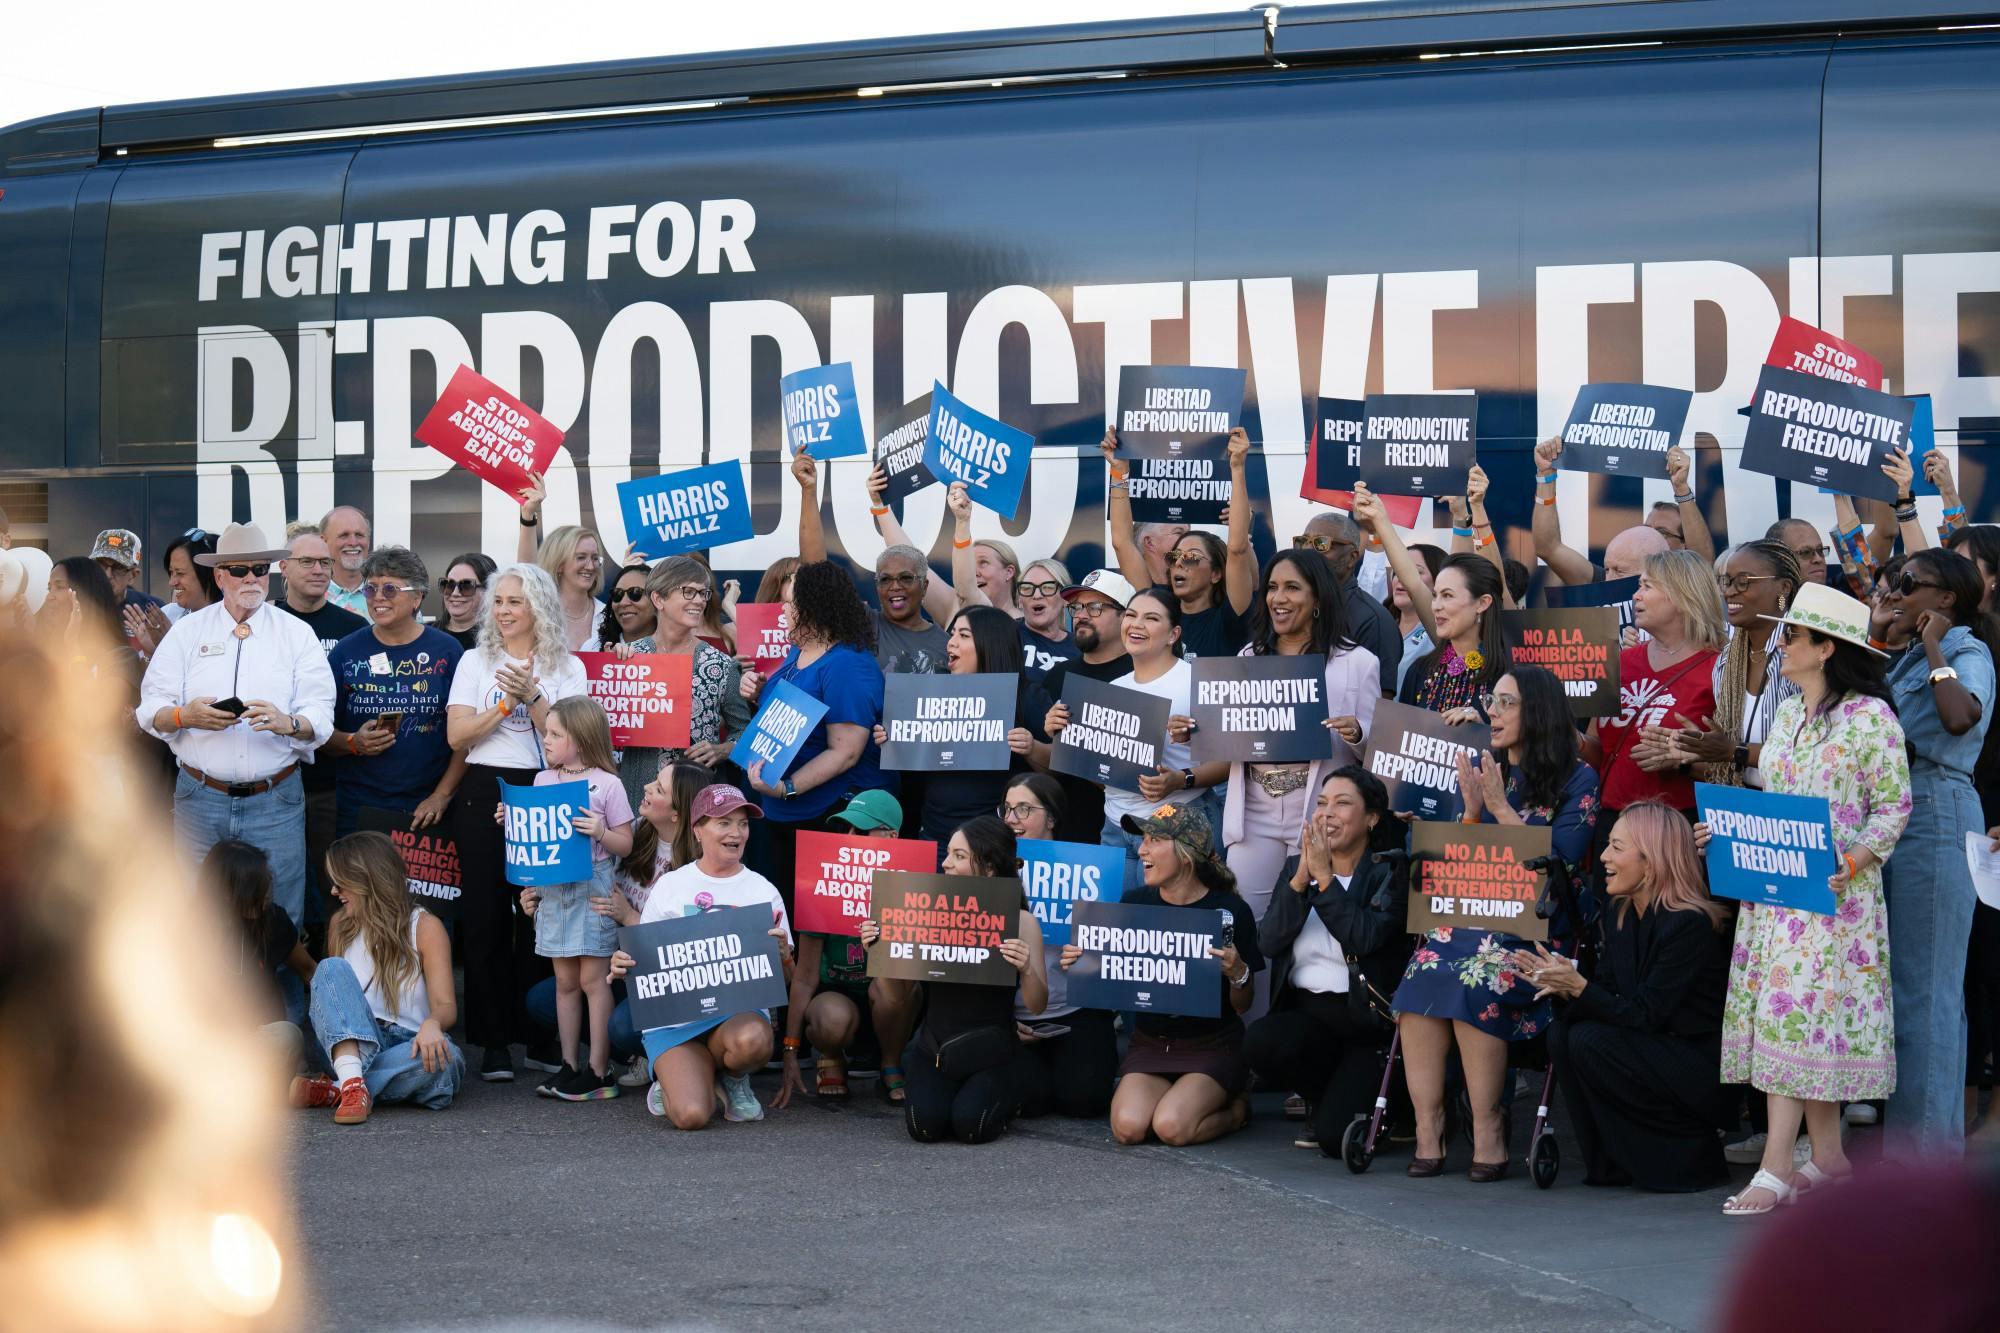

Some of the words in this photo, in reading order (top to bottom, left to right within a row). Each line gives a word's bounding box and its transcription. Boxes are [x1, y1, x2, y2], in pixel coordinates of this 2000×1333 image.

[198, 209, 566, 301] FIGHTING
[587, 198, 757, 281] FOR
[1813, 343, 1857, 370] STOP
[785, 383, 841, 427] HARRIS
[1145, 387, 1211, 410] LIBERTAD
[484, 396, 530, 429] STOP
[1124, 411, 1229, 433] REPRODUCTIVA
[1590, 403, 1656, 428] LIBERTAD
[1761, 389, 1904, 446] REPRODUCTIVE
[464, 399, 536, 454] TRUMP'S
[792, 421, 833, 447] WALZ
[877, 413, 931, 461] REPRODUCTIV
[1367, 417, 1470, 442] REPRODUCTIVE
[1565, 424, 1671, 452] REPRODUCTIVA
[448, 410, 534, 471] ABORTION
[935, 405, 1011, 475] HARRIS
[1782, 424, 1872, 467] FREEDOM
[464, 438, 503, 469] BAN
[1385, 443, 1449, 468] FREEDOM
[938, 444, 991, 489] WALZ
[1142, 459, 1213, 479] LIBERTAD
[1128, 478, 1233, 501] EPRODUCTIVA
[637, 480, 730, 527] HARRIS
[656, 513, 721, 542] WALZ
[1523, 629, 1543, 645] NO
[1546, 629, 1558, 645] A
[1561, 628, 1584, 645] LA
[1512, 642, 1607, 663] PROHIBICIÓN
[602, 664, 651, 680] STOP
[1545, 663, 1607, 681] MISTA
[388, 696, 408, 704] too
[412, 694, 439, 704] hard
[587, 680, 667, 697] TRUMP'S
[1198, 678, 1320, 705] REPRODUCTIVE
[1564, 680, 1598, 697] UMP
[592, 697, 673, 714] BORTION
[916, 697, 986, 719] LIBERTAD
[607, 713, 644, 729] BAN
[757, 698, 808, 747] HARRIS
[890, 719, 1004, 743] REPRODUCTIVA
[1081, 702, 1141, 738] LIBERTAD
[1222, 706, 1296, 732] FREEDOM
[750, 731, 782, 764] WALZ
[1060, 723, 1155, 768] REPRODUCTIVA
[1371, 750, 1459, 794] REPRODUC
[503, 802, 573, 843] ARRIS
[1705, 808, 1828, 850] REPRODUCTIVE
[390, 830, 416, 847] NO
[418, 836, 431, 851] A
[435, 838, 457, 855] LA
[505, 841, 561, 866] WALZ
[1444, 843, 1470, 861] NO
[1474, 844, 1487, 862] A
[1491, 845, 1515, 863] LA
[838, 847, 891, 867] STOP
[1731, 841, 1808, 878] FREEDOM
[821, 863, 900, 883] TRUM
[1018, 860, 1100, 901] ARRIS
[1422, 859, 1538, 883] PROHIBICIÓN
[814, 880, 872, 901] ABORT
[904, 892, 931, 909] NO
[934, 894, 949, 911] A
[954, 895, 979, 912] LA
[1422, 879, 1536, 900] EXTREMISTA
[842, 900, 871, 918] BA
[881, 908, 1005, 931] PROHIBICIÓN
[1027, 900, 1072, 925] ALZ
[1431, 896, 1455, 914] DE
[1460, 898, 1525, 918] TRUMP
[880, 925, 1001, 948] EXTREMISTA
[1077, 924, 1213, 959] REPRODUCTIVE
[657, 934, 742, 970] LIBERTAD
[890, 943, 914, 959] DE
[919, 945, 990, 964] TRUMP
[635, 954, 773, 1000] REPRODUCTIVA
[1101, 955, 1186, 985] FREEDOM
